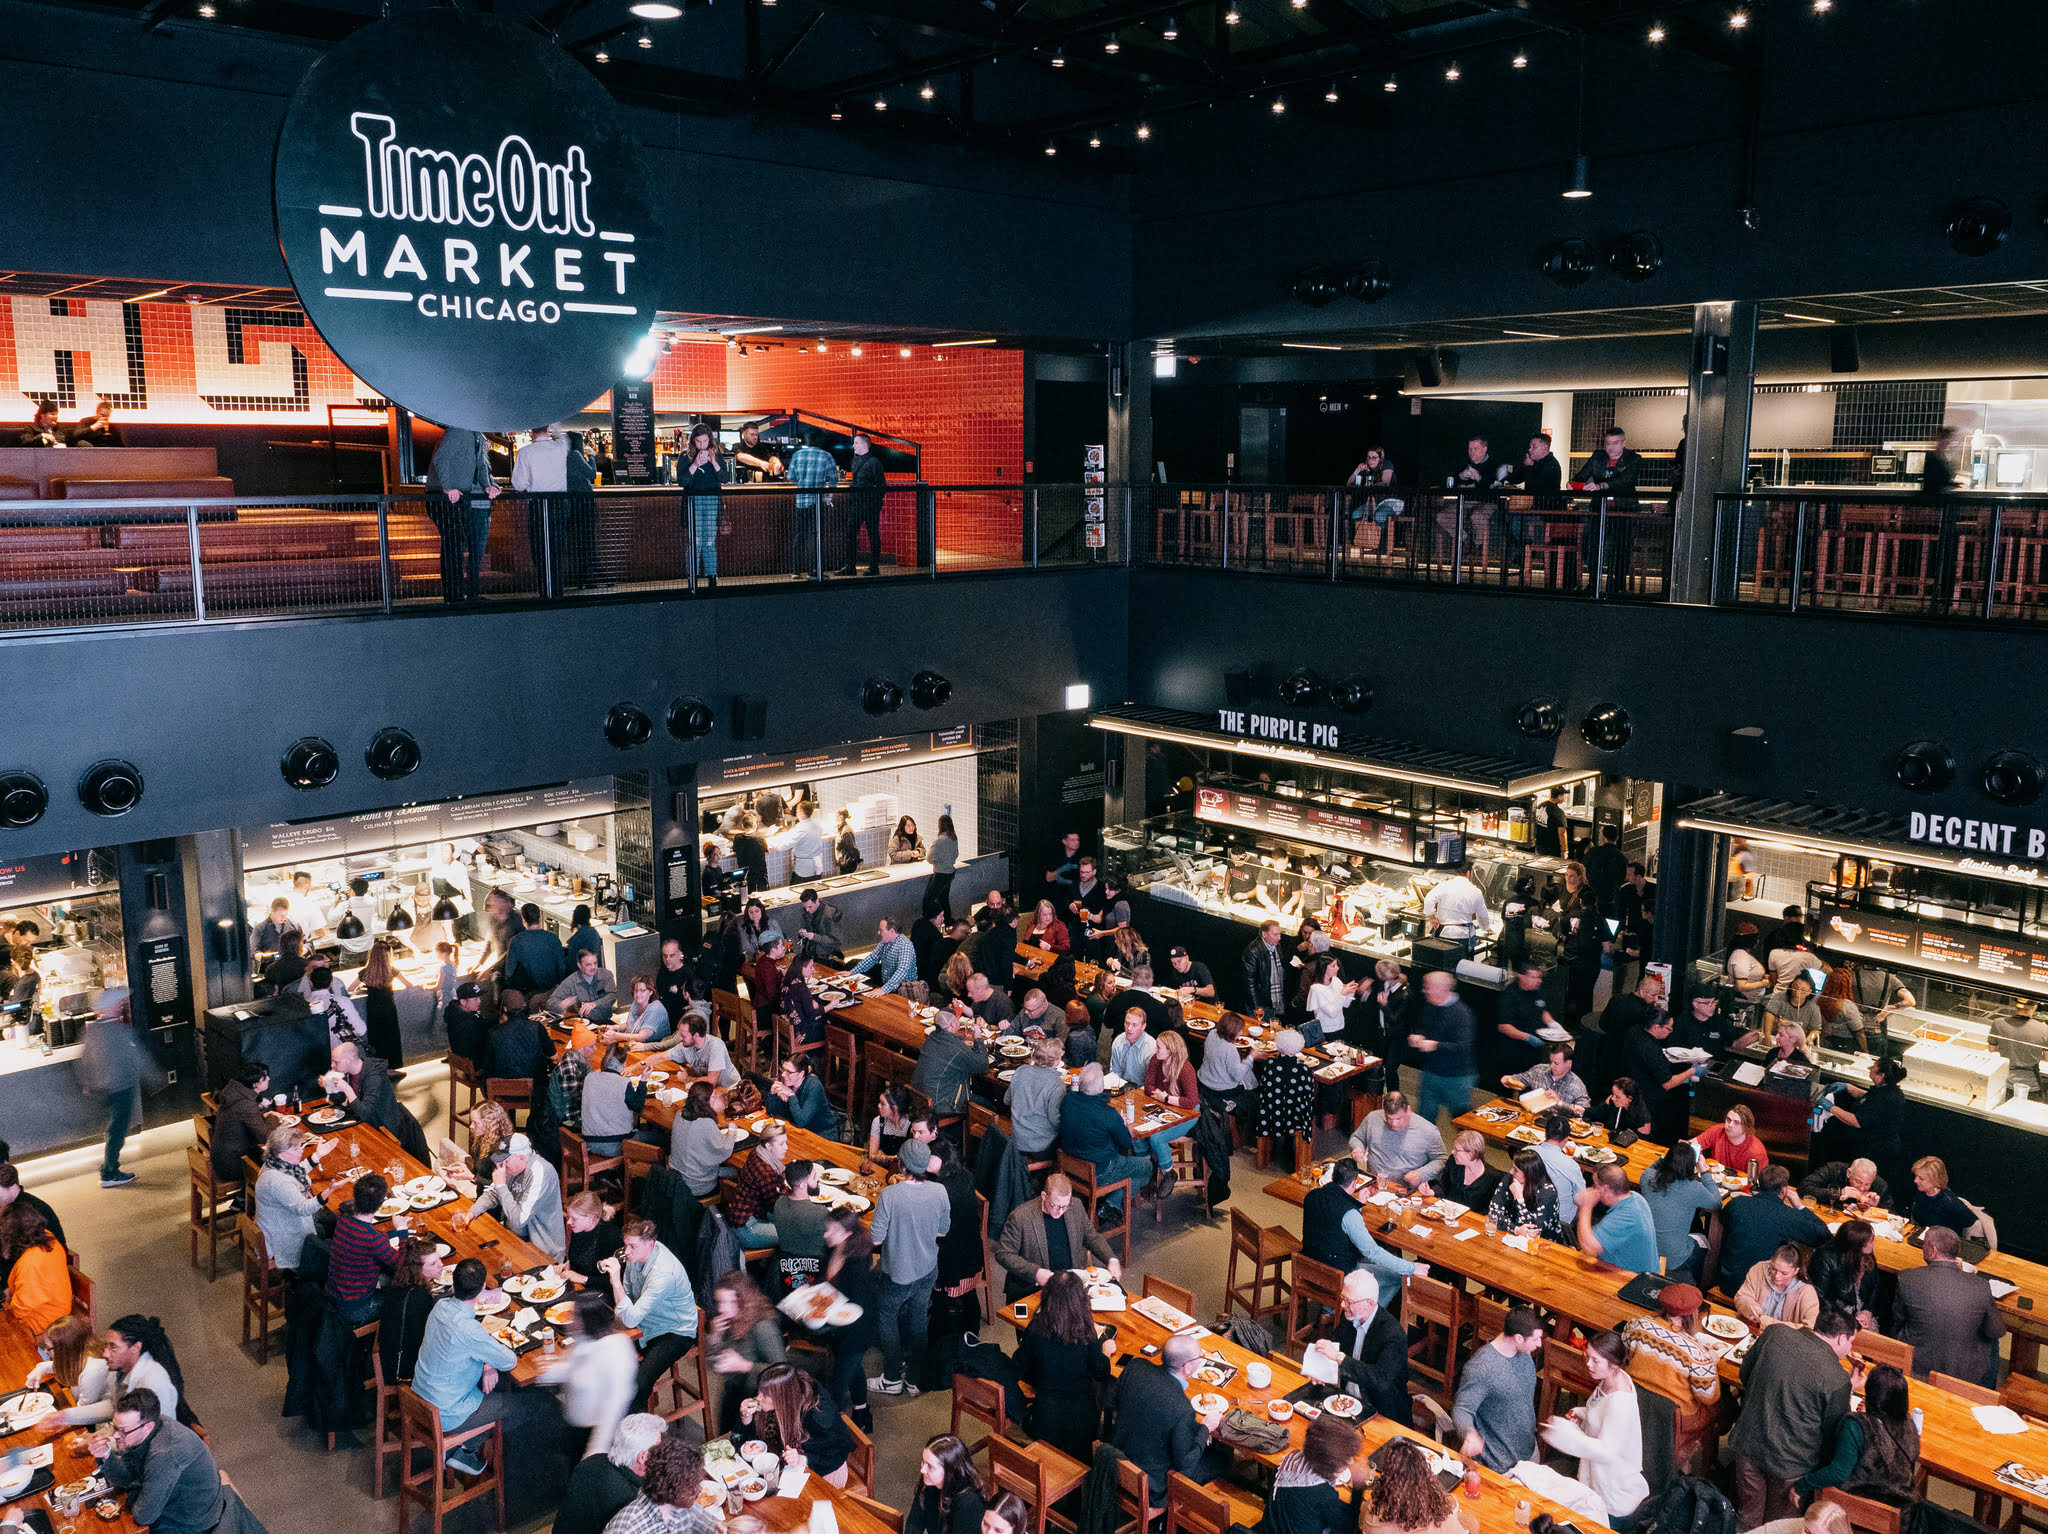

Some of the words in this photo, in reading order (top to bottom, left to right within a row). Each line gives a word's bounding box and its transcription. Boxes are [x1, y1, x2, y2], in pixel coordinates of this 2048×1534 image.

[320, 227, 636, 295] MARKET
[418, 294, 561, 324] CHICAGO
[1219, 709, 1245, 733] THE
[1250, 714, 1307, 743] PURPLE
[1312, 723, 1338, 748] PIG
[272, 831, 301, 839] WALLEYE
[1910, 811, 2017, 854] DECENT
[780, 1258, 819, 1273] RICHIE
